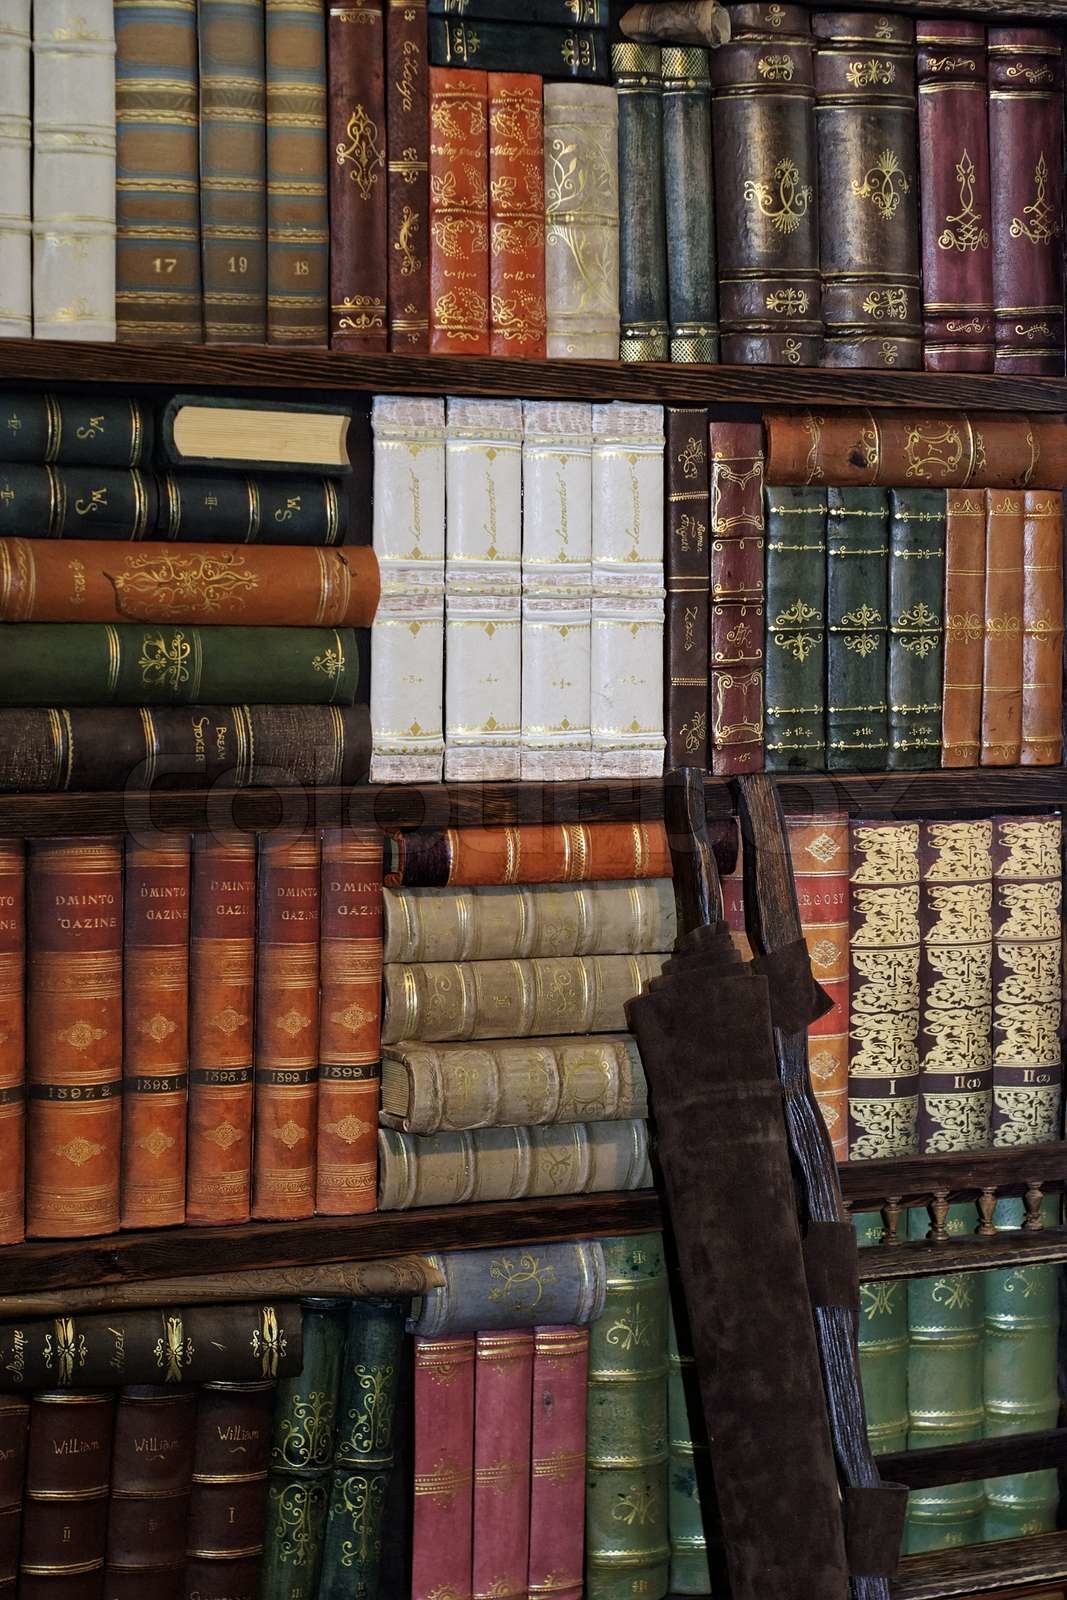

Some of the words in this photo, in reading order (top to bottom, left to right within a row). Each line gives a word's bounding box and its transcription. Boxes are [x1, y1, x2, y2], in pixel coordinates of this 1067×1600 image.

[153, 258, 177, 273] 17
[228, 256, 248, 272] 19
[294, 261, 309, 275] 18
[799, 892, 845, 906] RGOSY
[889, 1079, 897, 1095] I
